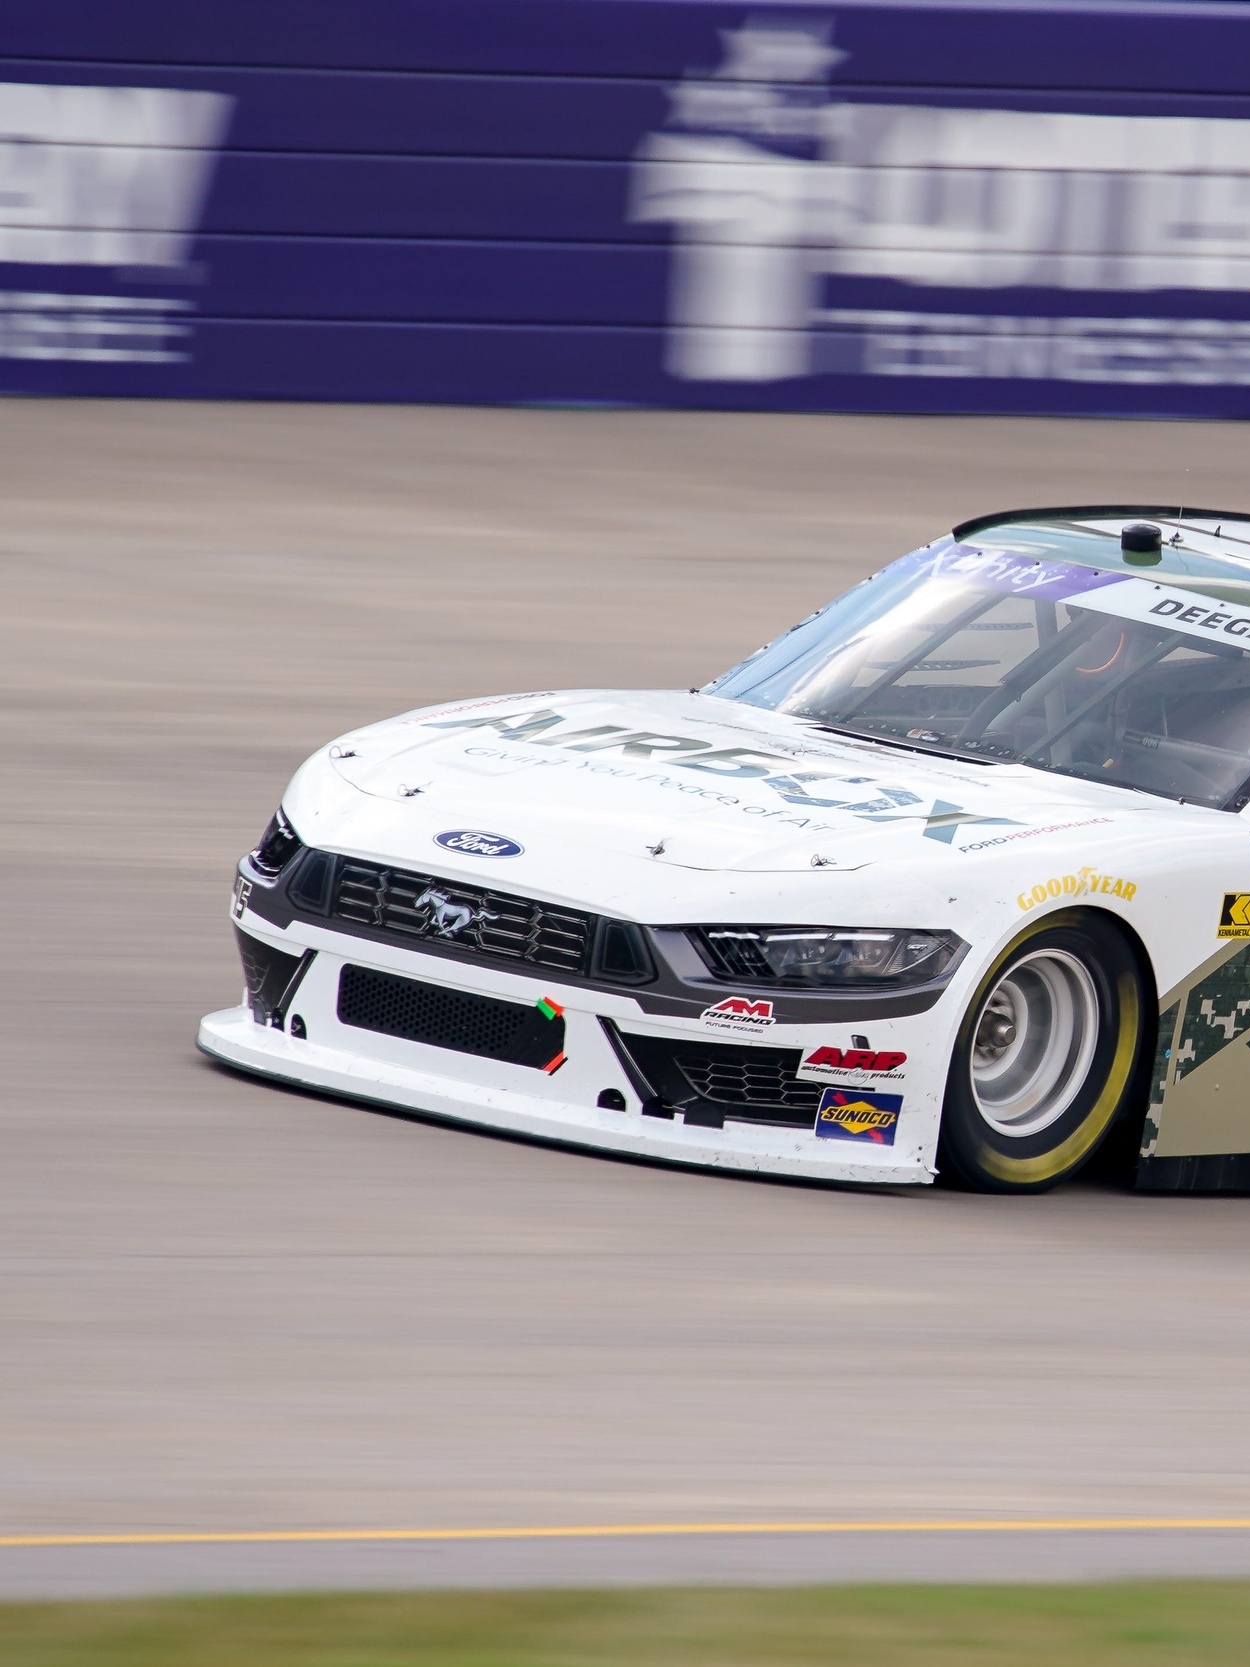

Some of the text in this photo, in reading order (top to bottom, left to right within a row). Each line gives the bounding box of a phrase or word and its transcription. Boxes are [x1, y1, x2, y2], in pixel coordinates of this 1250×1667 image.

[419, 708, 1034, 845] AIRBOX
[463, 746, 570, 768] Giving
[636, 773, 741, 806] Peace
[742, 805, 792, 818] of
[778, 817, 838, 832] Air
[446, 831, 510, 855] Ford
[1217, 928, 1250, 937] KENNAMETAL
[713, 998, 771, 1017] AM
[704, 1011, 774, 1026] RACING
[704, 1021, 764, 1034] FUTURE FOCUSED
[803, 1045, 908, 1072] ARP
[800, 1064, 849, 1077] automotive
[869, 1071, 906, 1080] products
[822, 1107, 895, 1126] SUNOCO
